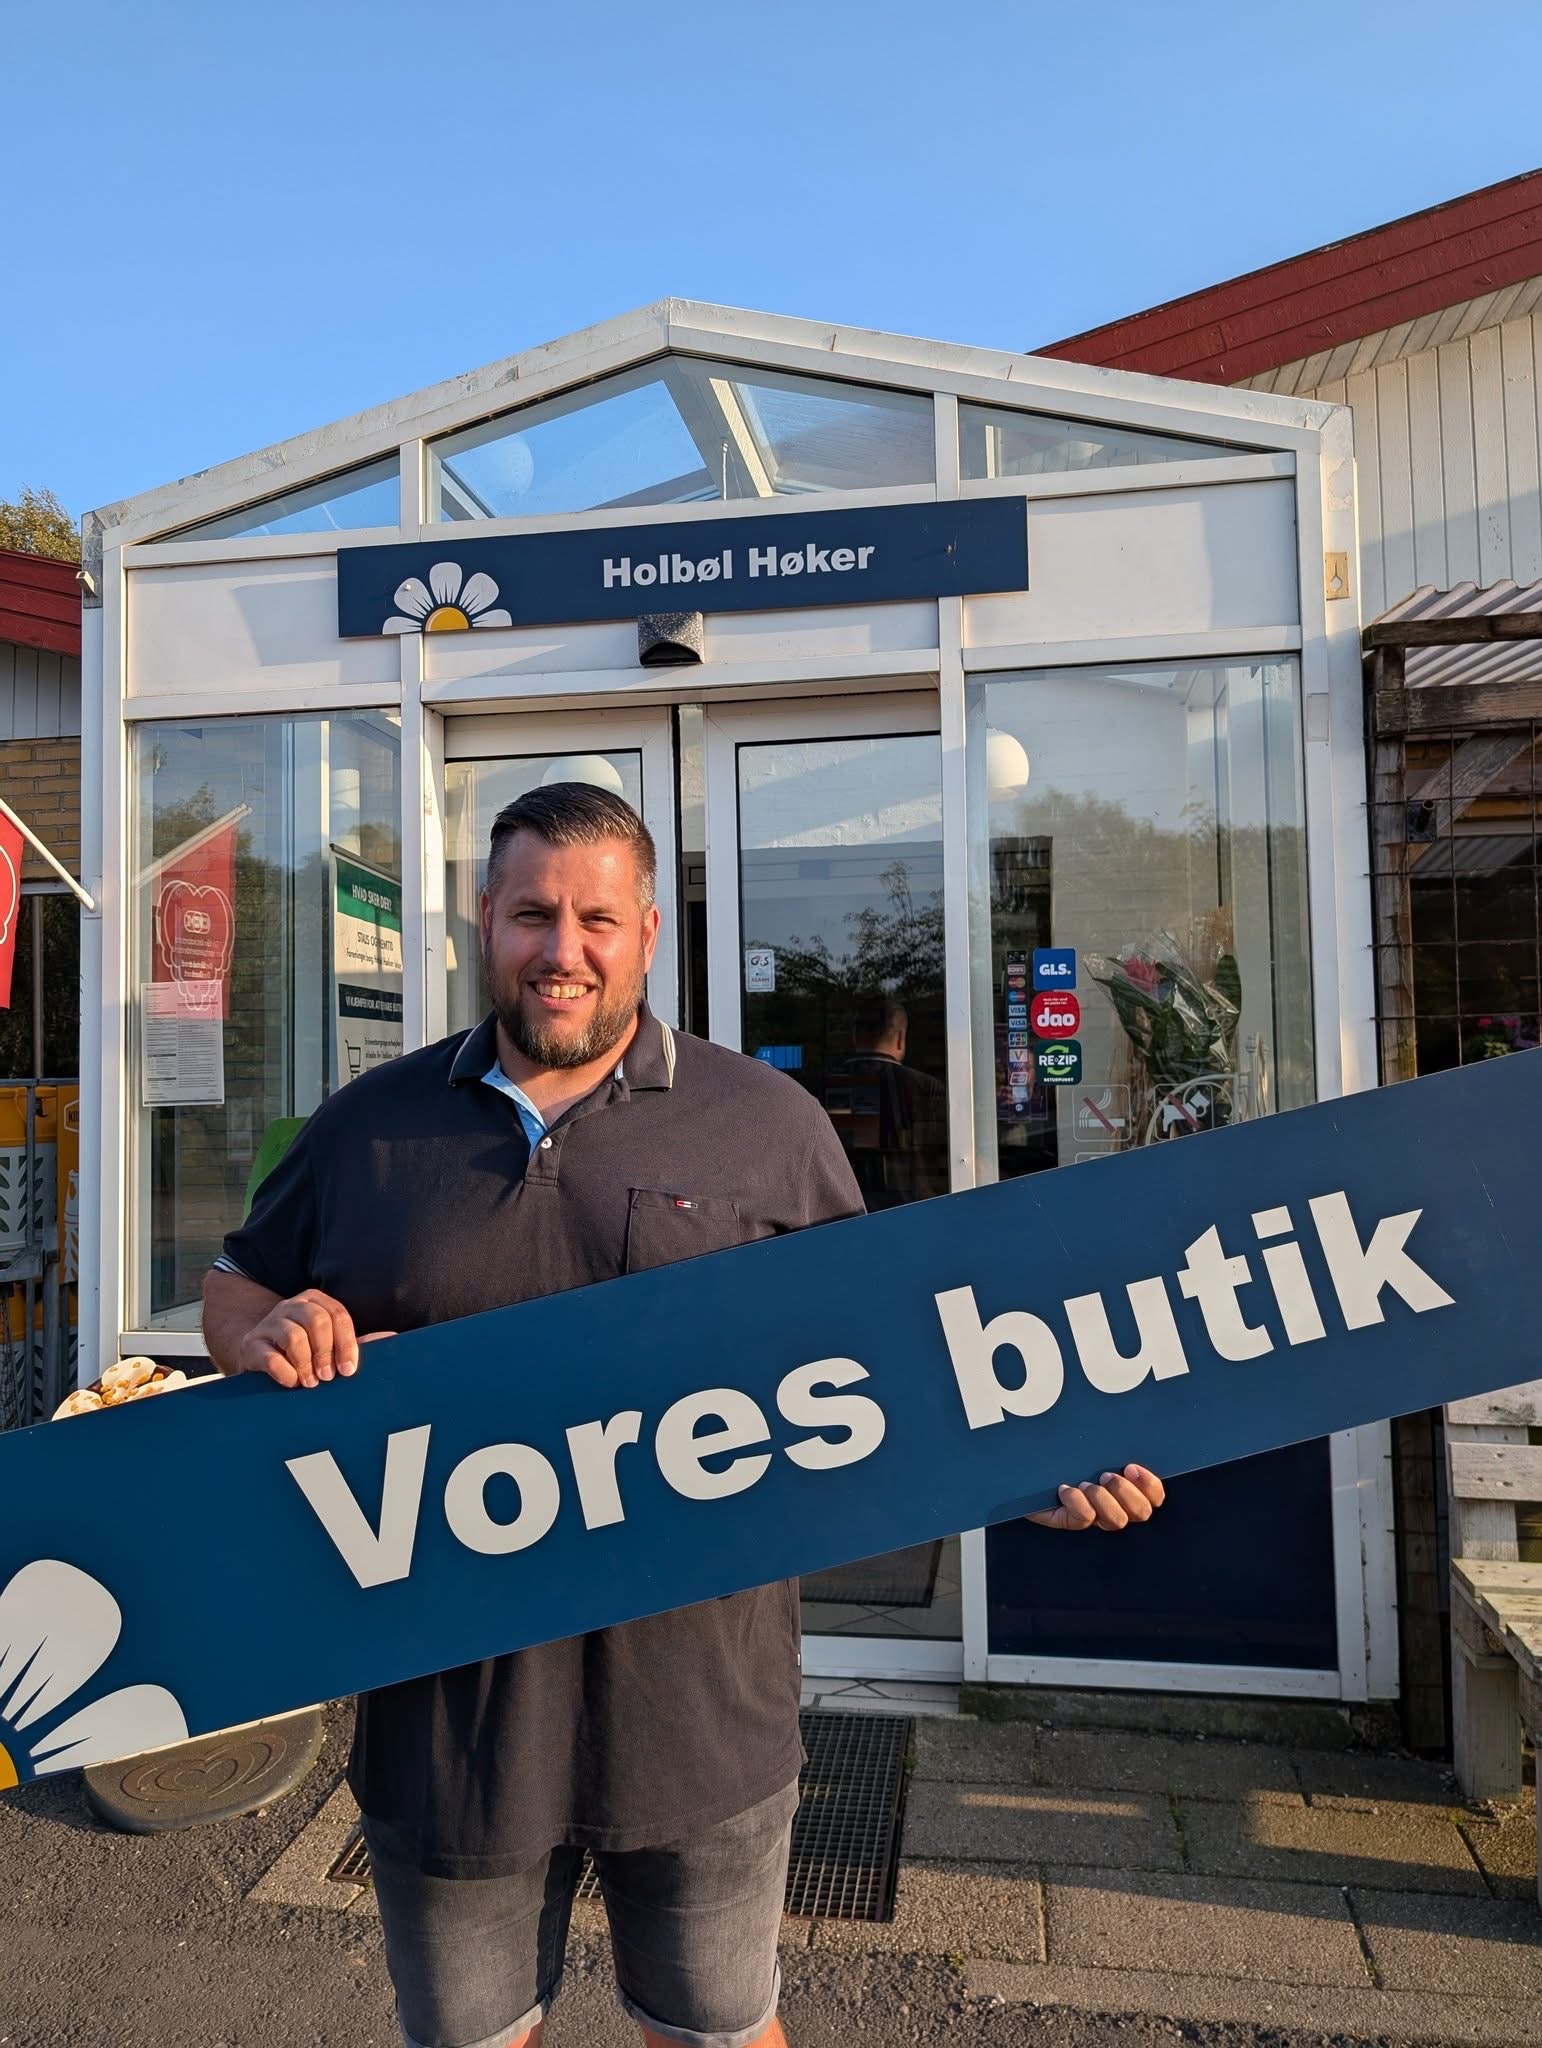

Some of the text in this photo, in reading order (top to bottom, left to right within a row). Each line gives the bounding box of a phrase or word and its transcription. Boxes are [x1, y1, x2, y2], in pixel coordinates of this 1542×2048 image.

[603, 543, 875, 589] Holbøl Høker
[352, 884, 367, 903] HVAD
[367, 890, 380, 908] SKER
[1037, 1007, 1076, 1027] dao
[285, 1189, 1457, 1589] Vores butik
